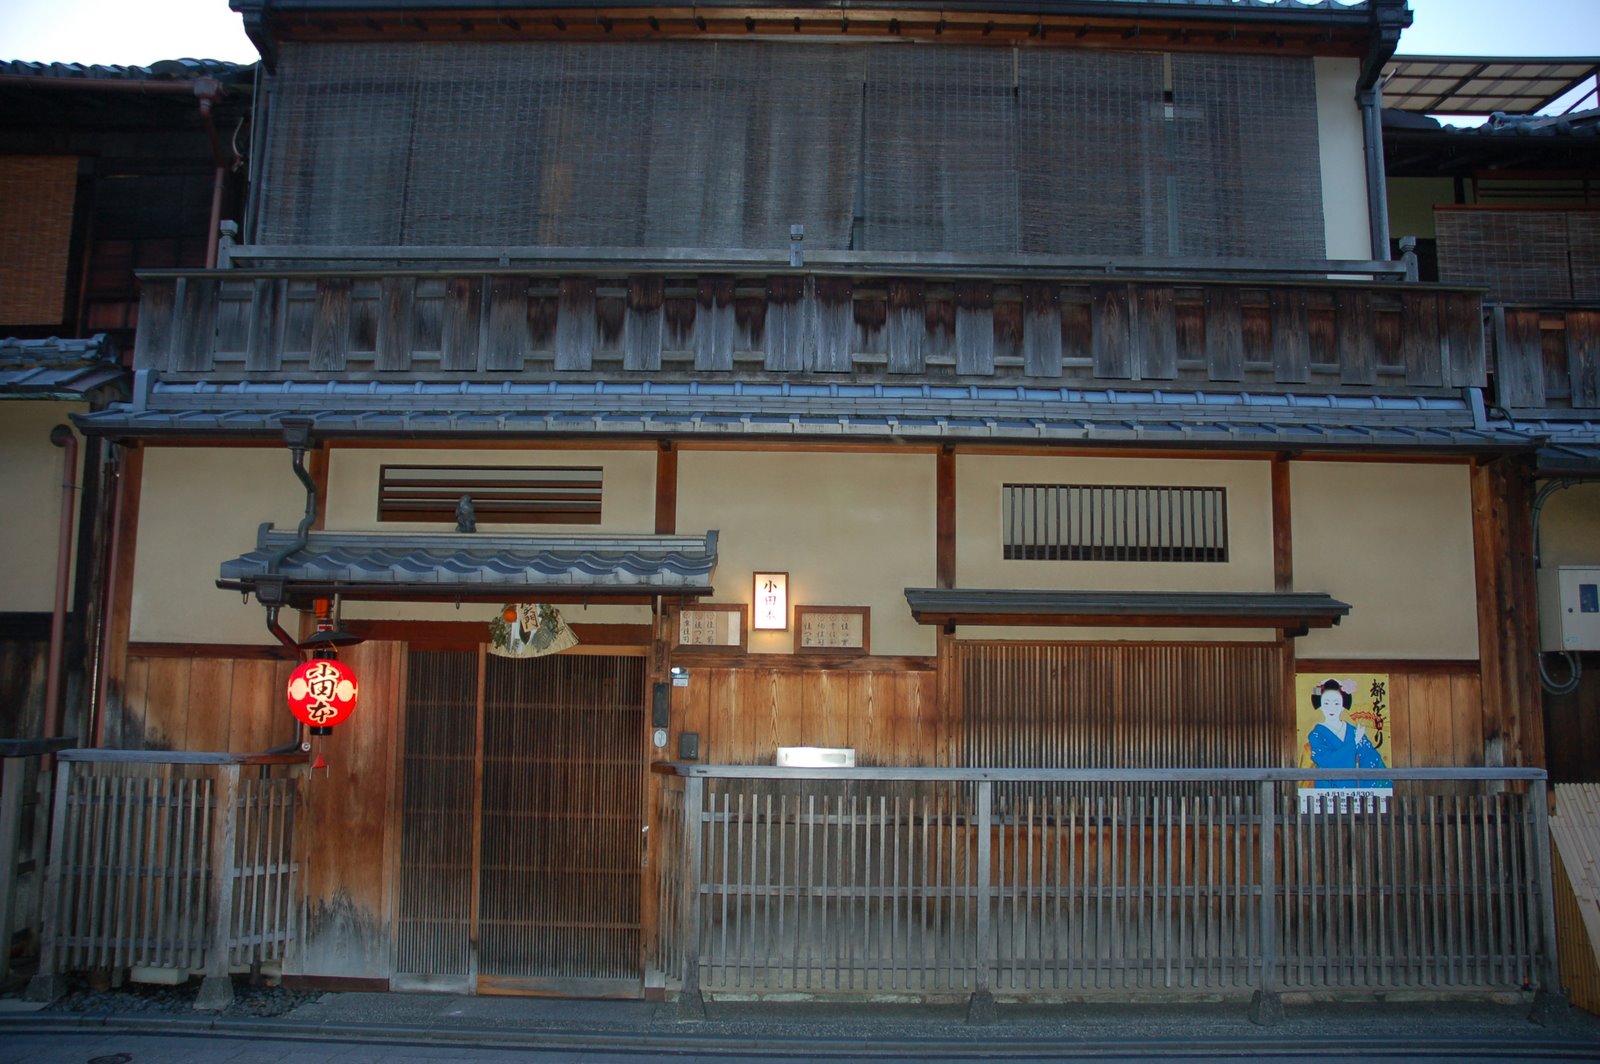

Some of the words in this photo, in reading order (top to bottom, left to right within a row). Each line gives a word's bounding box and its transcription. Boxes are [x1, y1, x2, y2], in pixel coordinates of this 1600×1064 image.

[308, 662, 337, 722] 小田本
[1370, 679, 1386, 749] 都をどり
